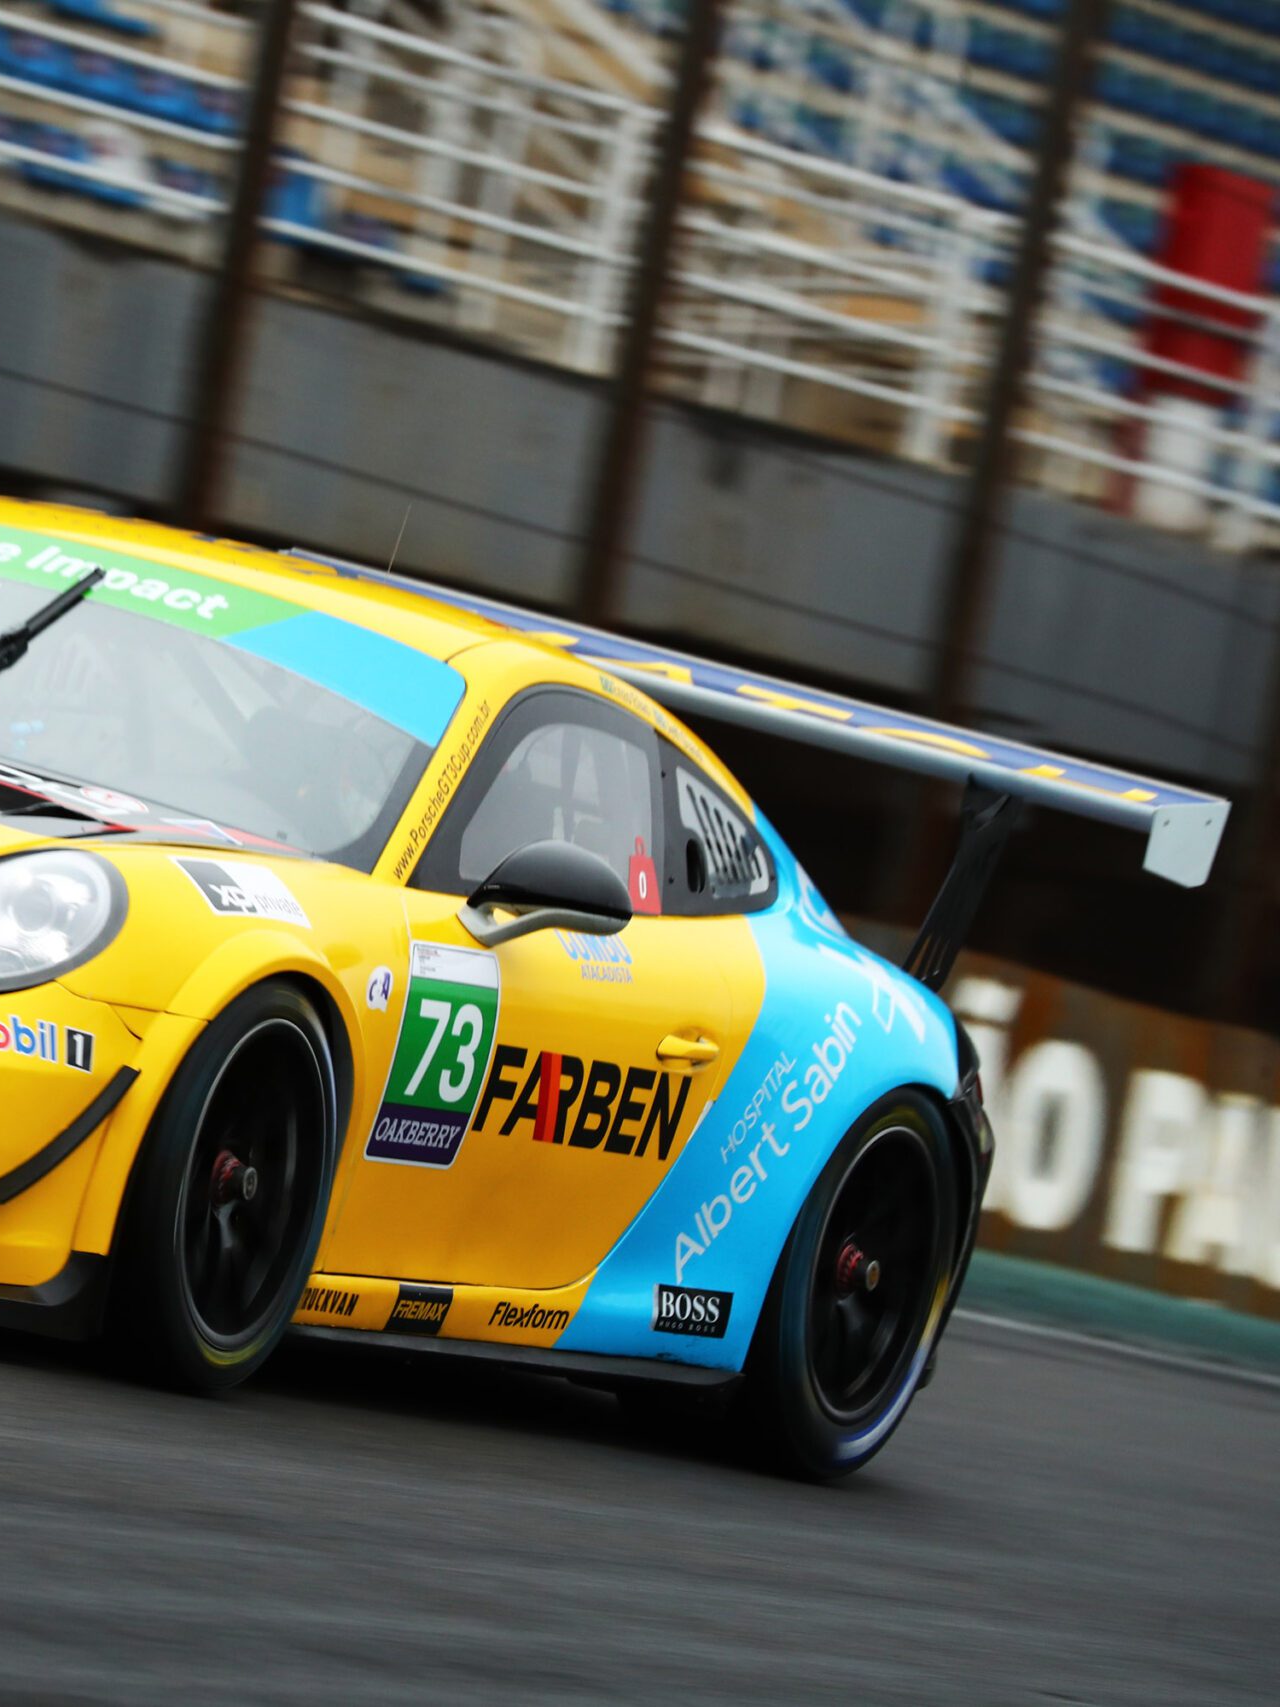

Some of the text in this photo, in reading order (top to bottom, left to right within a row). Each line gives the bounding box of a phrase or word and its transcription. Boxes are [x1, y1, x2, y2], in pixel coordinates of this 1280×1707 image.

[25, 546, 229, 620] Impact
[392, 699, 492, 881] www.PorscheGT3Cup.com.br
[403, 998, 484, 1103] 73
[374, 1116, 462, 1151] OAKBERRY
[470, 1043, 693, 1162] FARBEN
[673, 1001, 863, 1286] Albert Sabin
[720, 1050, 798, 1165] HOSPITAL
[392, 1299, 449, 1322] FREMAX
[488, 1300, 571, 1331] Flexform
[660, 1290, 721, 1324] BOSS
